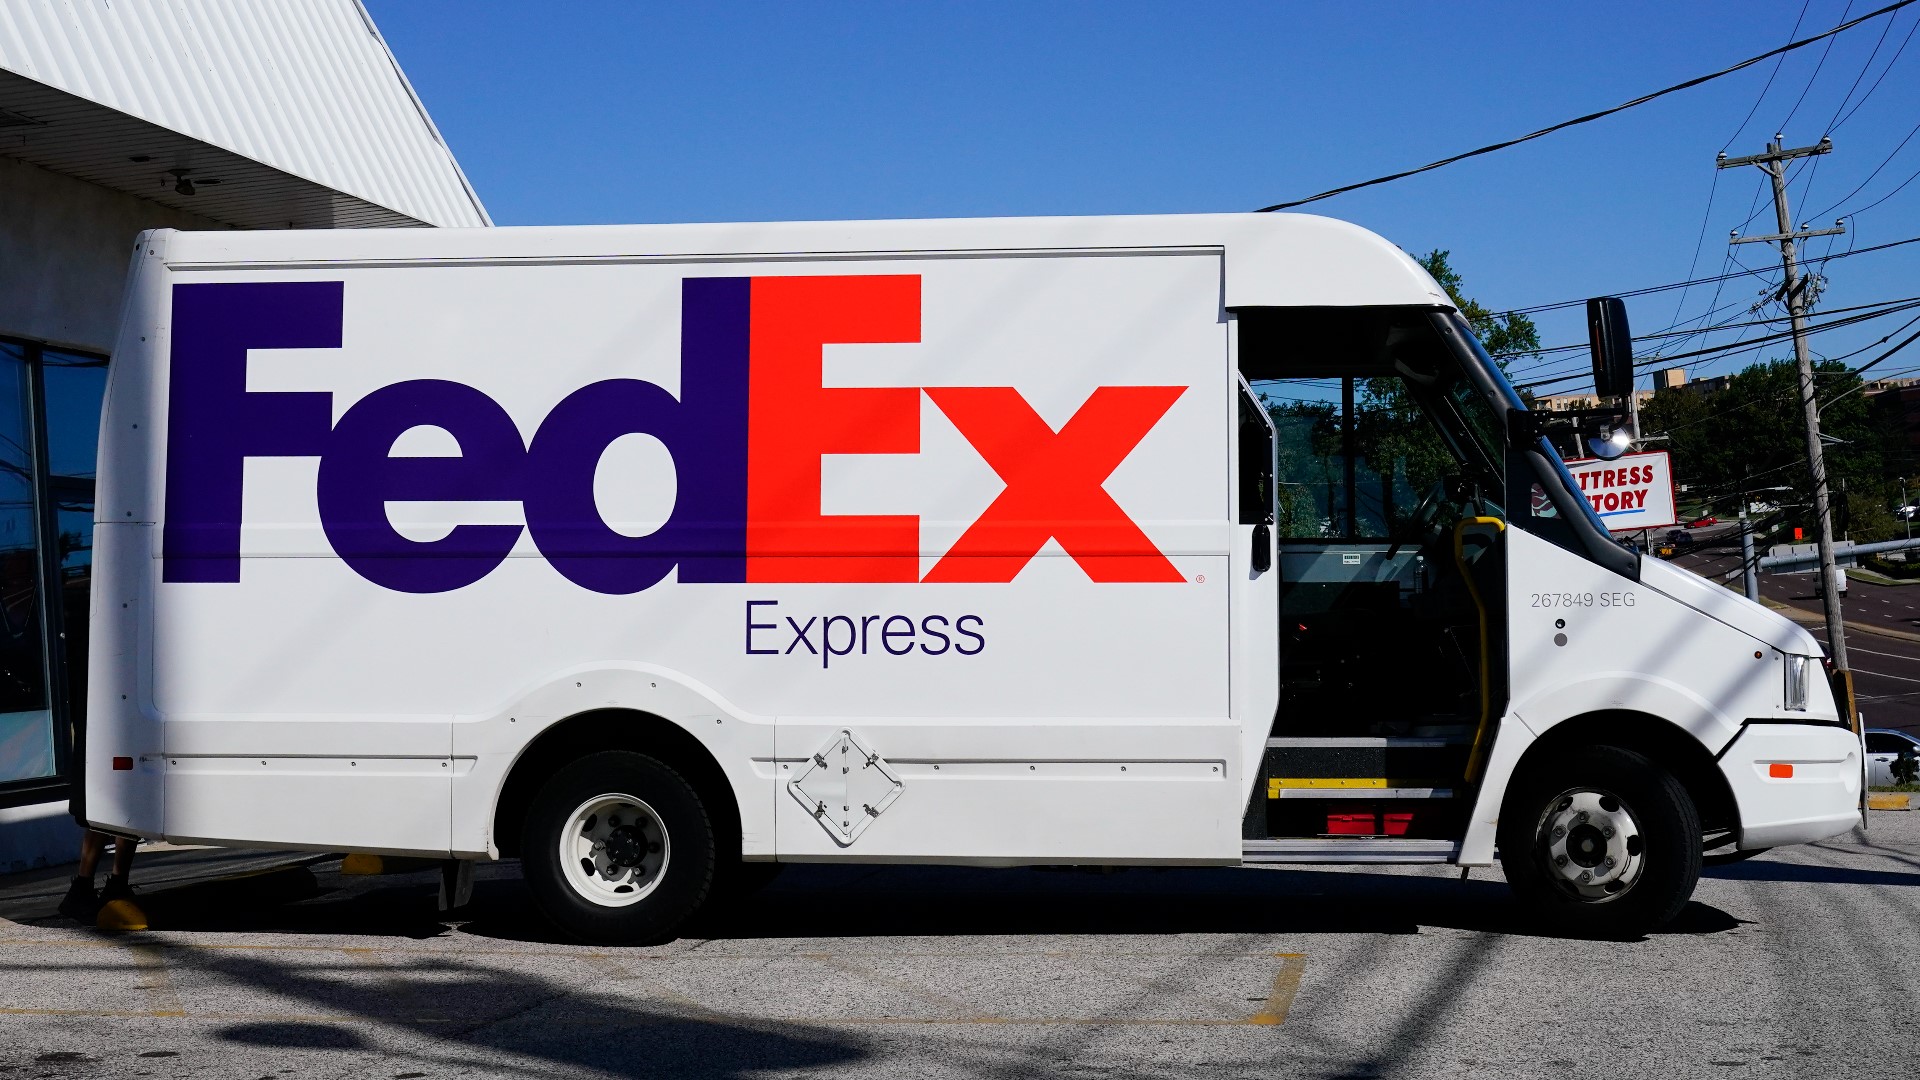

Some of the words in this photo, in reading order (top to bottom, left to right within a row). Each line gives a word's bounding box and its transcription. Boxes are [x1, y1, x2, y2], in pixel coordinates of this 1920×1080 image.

[163, 274, 1188, 595] FedEx
[1572, 465, 1653, 491] TTRESS
[1586, 489, 1648, 513] TORY
[1531, 593, 1594, 608] 267849
[1600, 592, 1635, 607] SEG
[746, 600, 985, 669] Express
